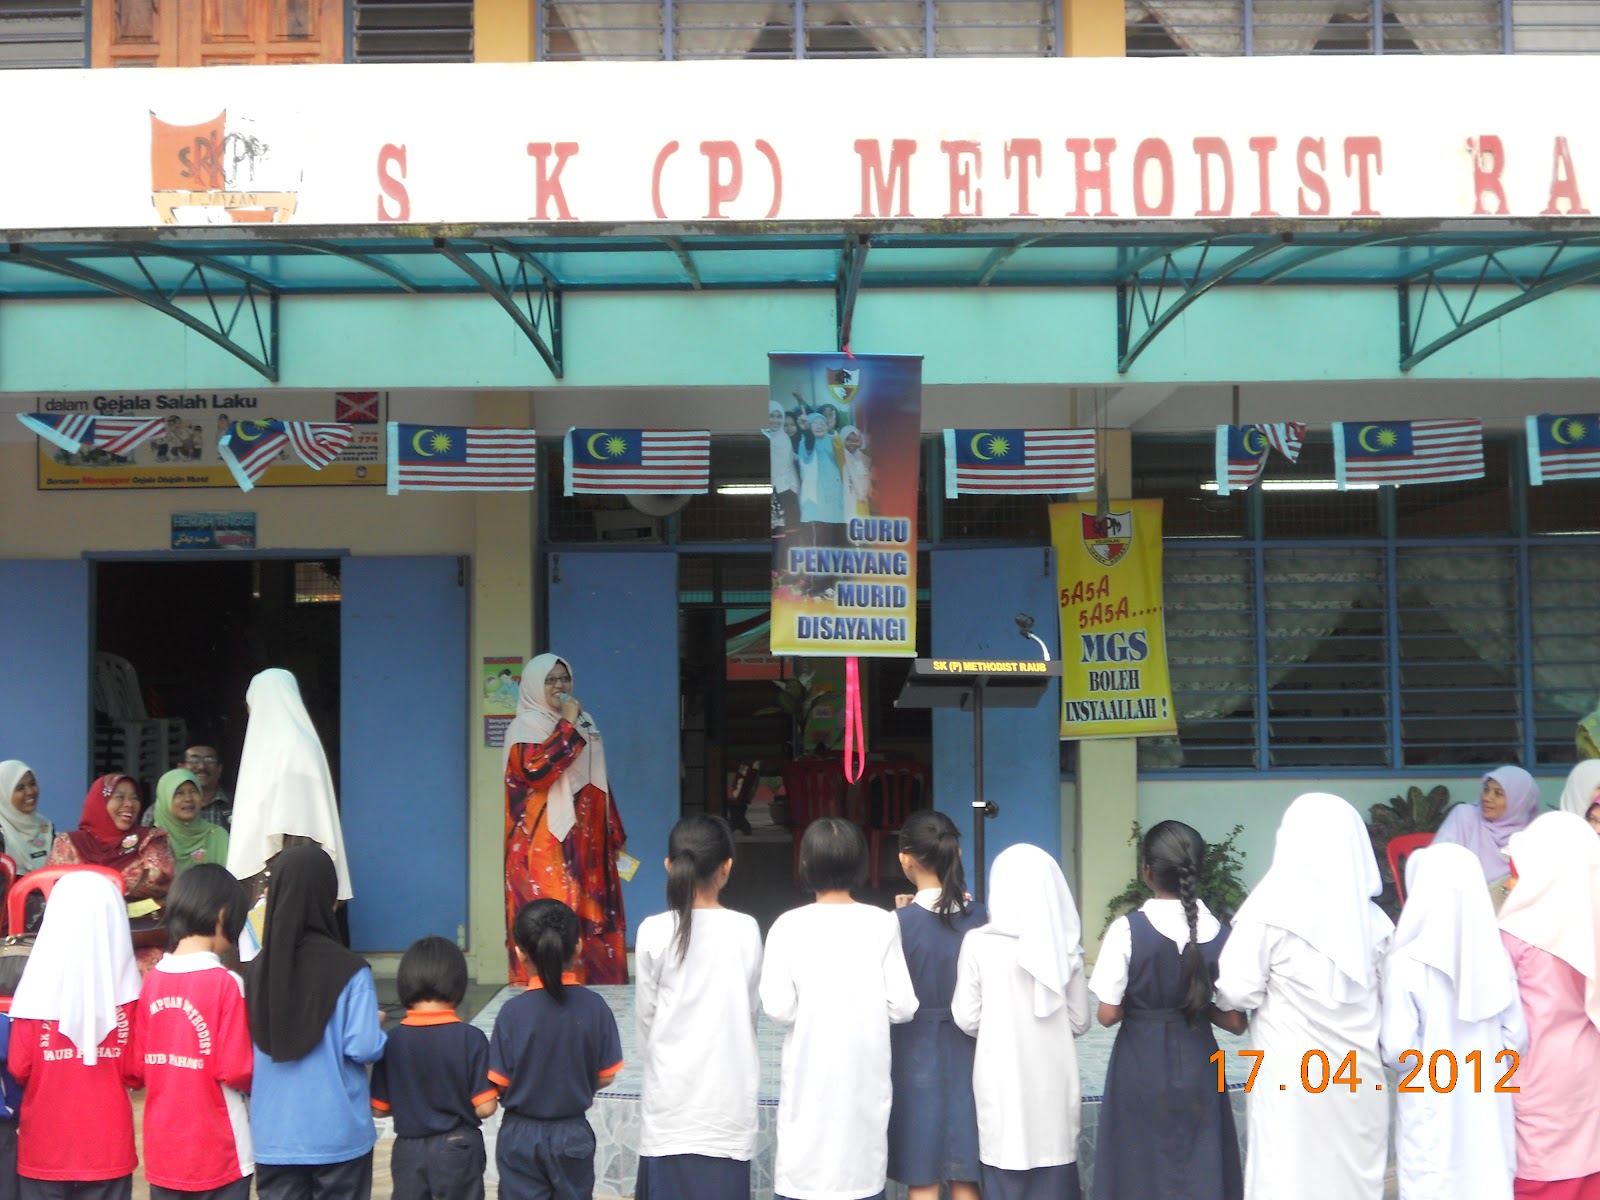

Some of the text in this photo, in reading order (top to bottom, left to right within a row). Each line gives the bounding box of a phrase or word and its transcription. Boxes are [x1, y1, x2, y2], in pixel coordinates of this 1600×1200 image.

[377, 142, 410, 221] S
[526, 141, 580, 221] K
[853, 135, 1383, 218] METHODIST
[45, 393, 257, 414] dalam Gejala Salah Laku
[850, 518, 908, 543] GURU
[791, 549, 908, 576] PENYAYANG
[837, 583, 907, 609] MURID
[797, 616, 906, 641] DISAYANGI
[1080, 631, 1148, 663] MGS
[933, 661, 948, 671] SK
[964, 661, 1018, 672] METHODIST
[1019, 663, 1047, 672] RAUB
[1088, 669, 1141, 692] BOLEH
